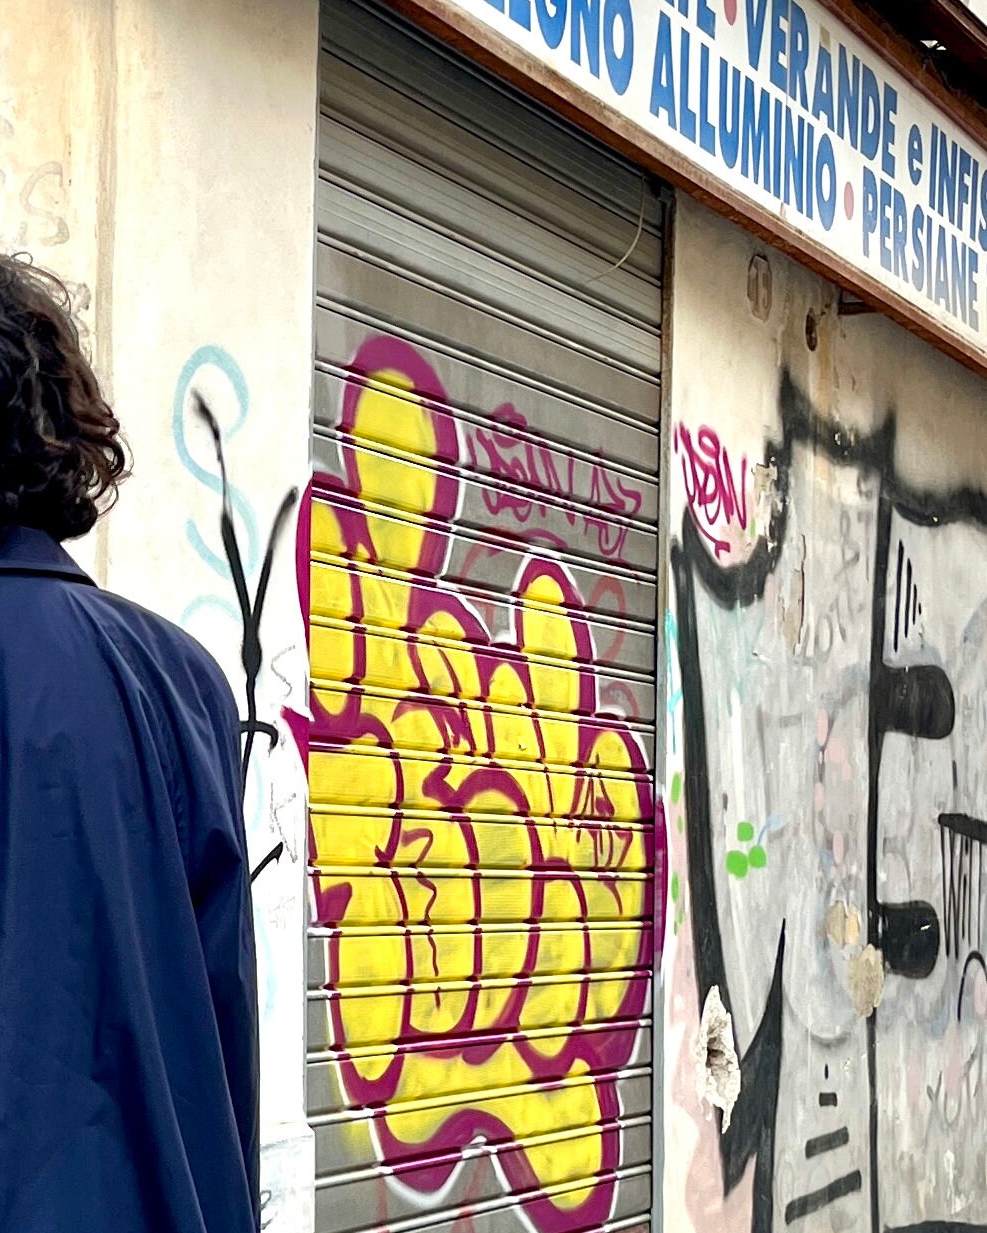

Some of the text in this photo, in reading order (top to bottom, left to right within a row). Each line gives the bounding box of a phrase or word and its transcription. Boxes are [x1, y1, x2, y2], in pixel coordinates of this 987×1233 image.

[649, 10, 837, 232] ALLUMINIO
[862, 165, 980, 332] PERSIANE
[745, 0, 898, 180] VERANDE
[908, 123, 923, 186] e
